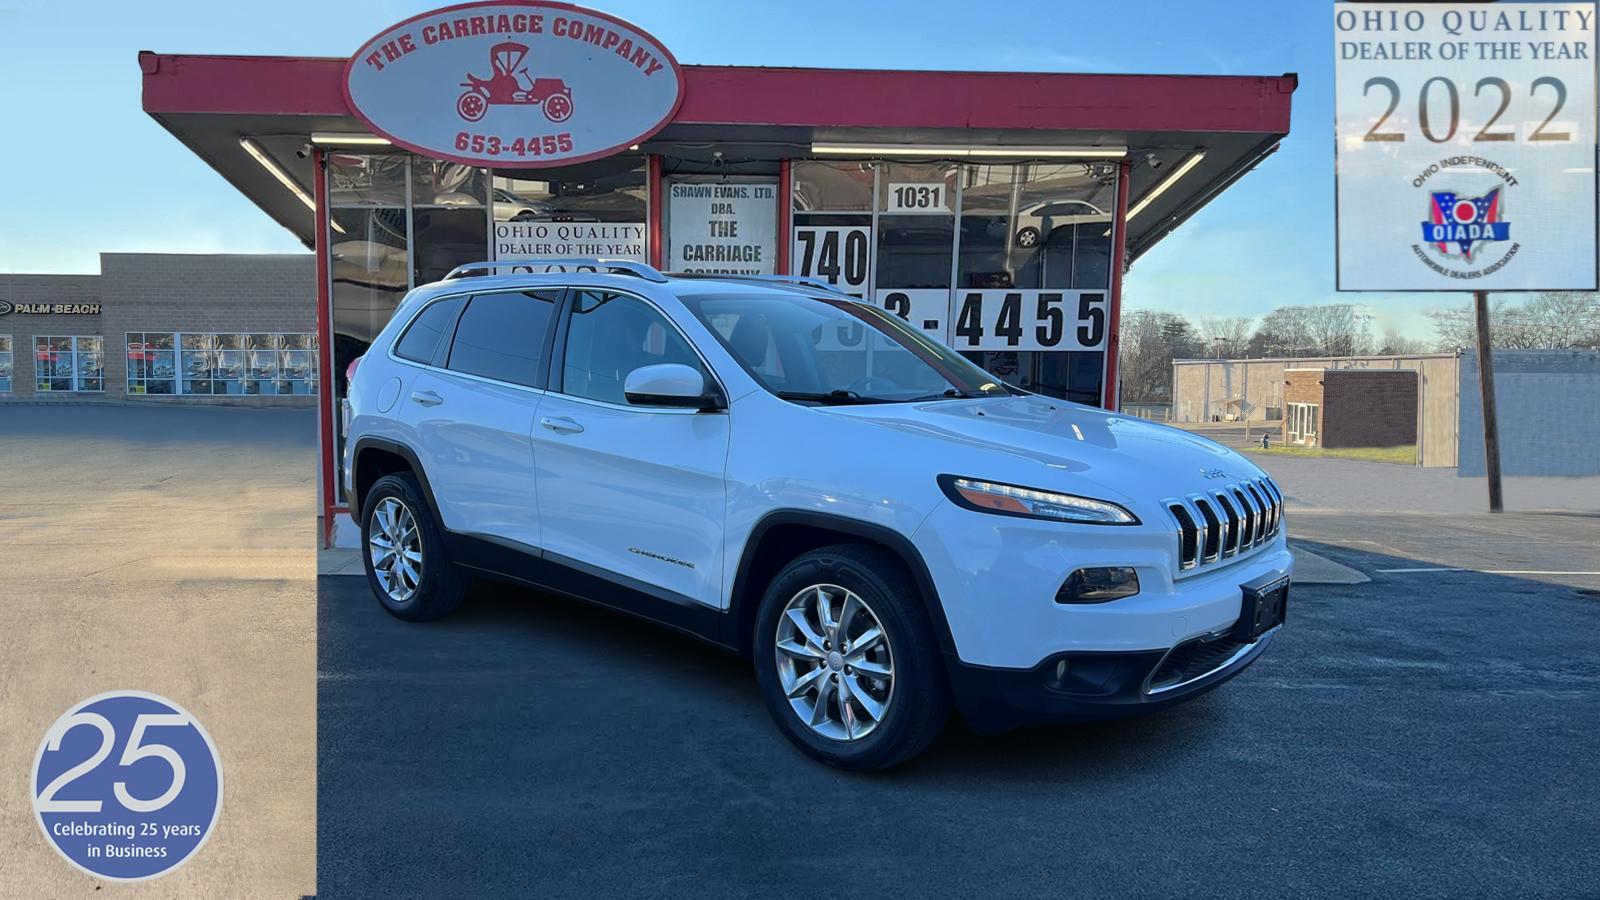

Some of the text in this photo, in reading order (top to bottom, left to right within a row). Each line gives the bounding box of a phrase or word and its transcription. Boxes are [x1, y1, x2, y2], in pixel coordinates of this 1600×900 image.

[1336, 10, 1593, 35] OHIO QUALITY
[365, 14, 664, 77] THE CARRIAGE COMPANY
[1340, 42, 1589, 60] DEALER OF THE YEAR
[1363, 76, 1571, 143] 2022
[454, 132, 573, 156] 653-4455
[1412, 156, 1519, 188] OHIO INDEPENDENT
[673, 186, 712, 198] SHAWN
[754, 187, 775, 200] LTD.
[894, 186, 940, 208] 1031
[711, 203, 736, 215] DBA.
[497, 226, 644, 240] OHIO QUALITY
[708, 220, 738, 238] THE
[1433, 224, 1496, 241] OIADA
[499, 244, 641, 255] DEALER OF THE YEAR
[683, 244, 762, 263] CARRIAGE
[797, 230, 868, 286] 740
[1449, 270, 1482, 279] DEALERS
[1482, 242, 1520, 276] ASSOCIATION
[15, 304, 51, 314] PALM
